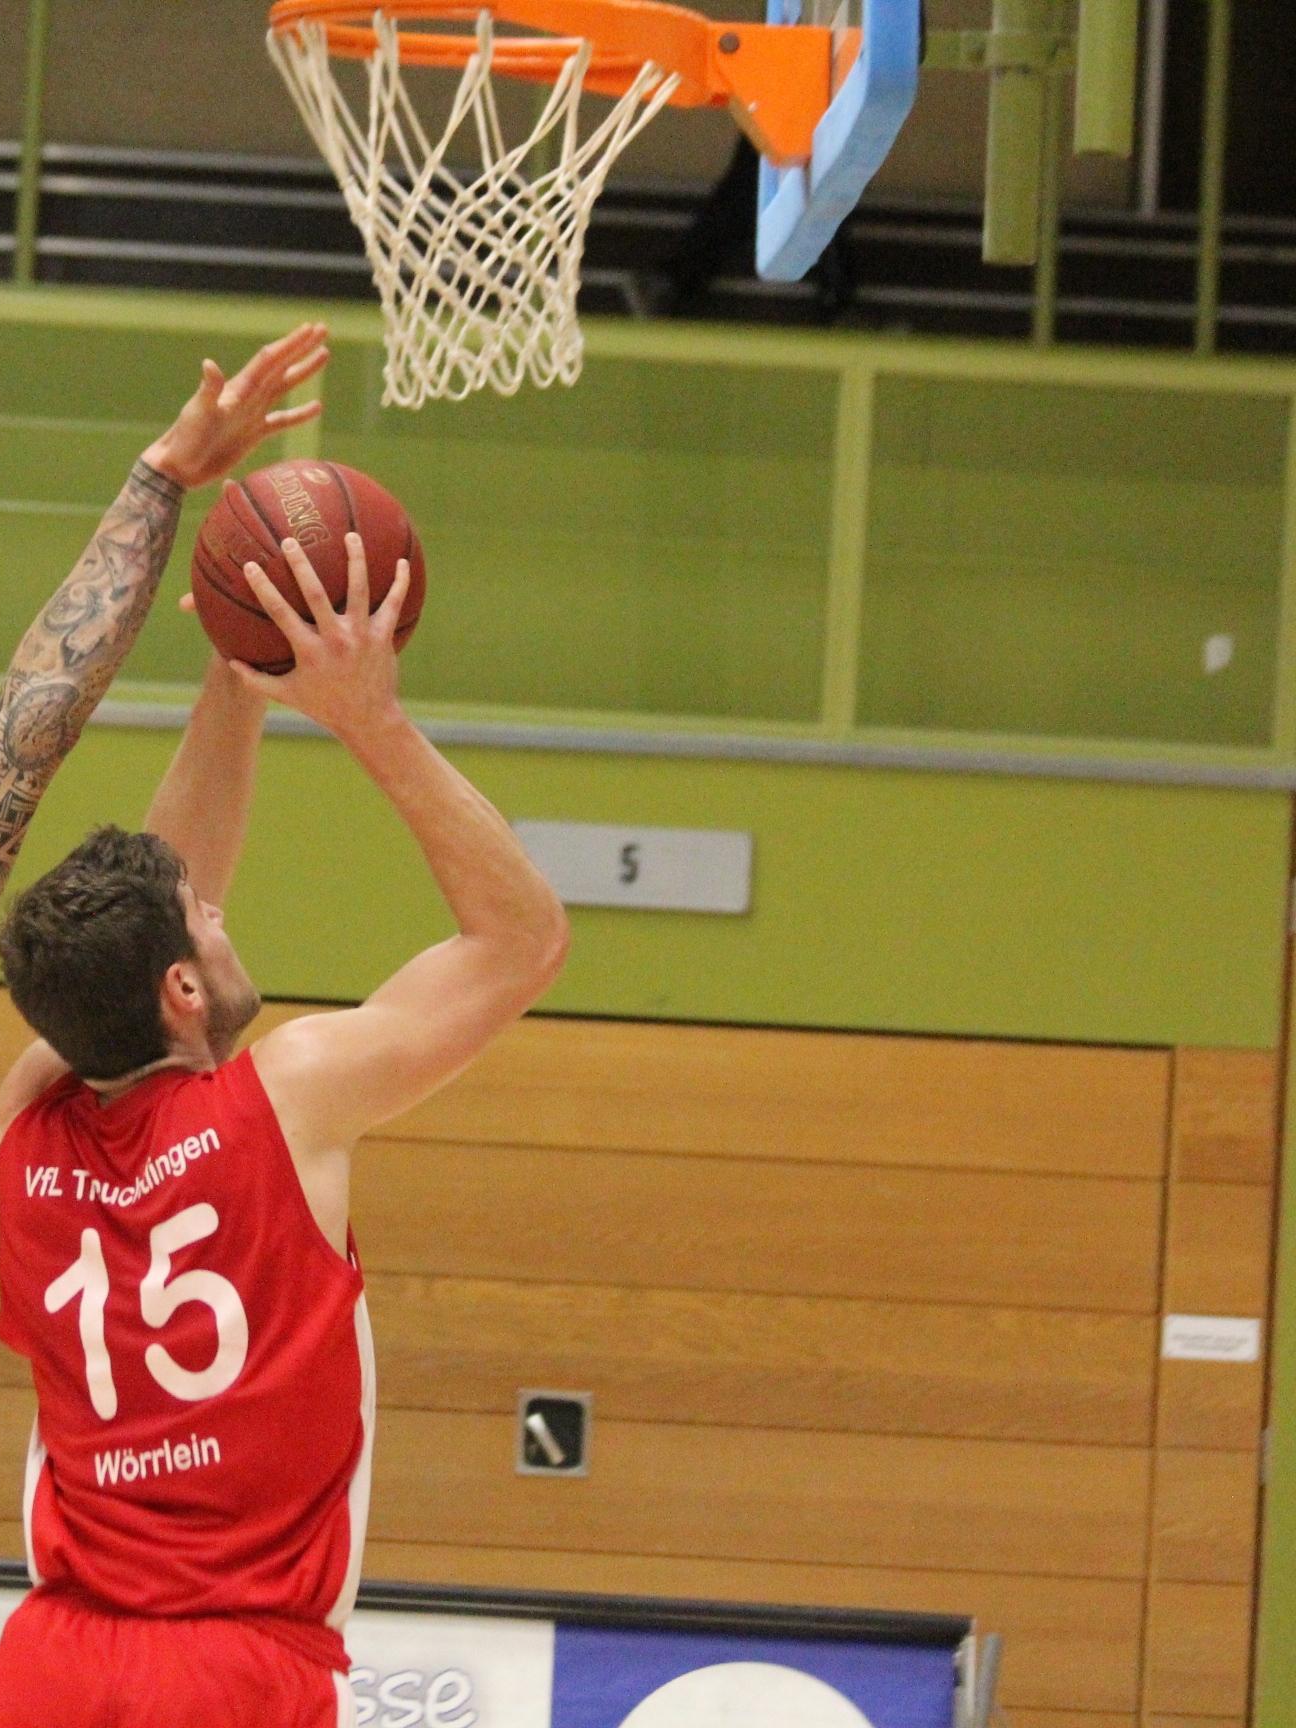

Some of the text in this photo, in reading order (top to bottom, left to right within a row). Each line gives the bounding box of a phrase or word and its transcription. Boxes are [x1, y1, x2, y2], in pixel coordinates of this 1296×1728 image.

[25, 1165, 63, 1198] VfL
[44, 1202, 249, 1421] 15
[94, 1432, 221, 1488] Wörrlein
